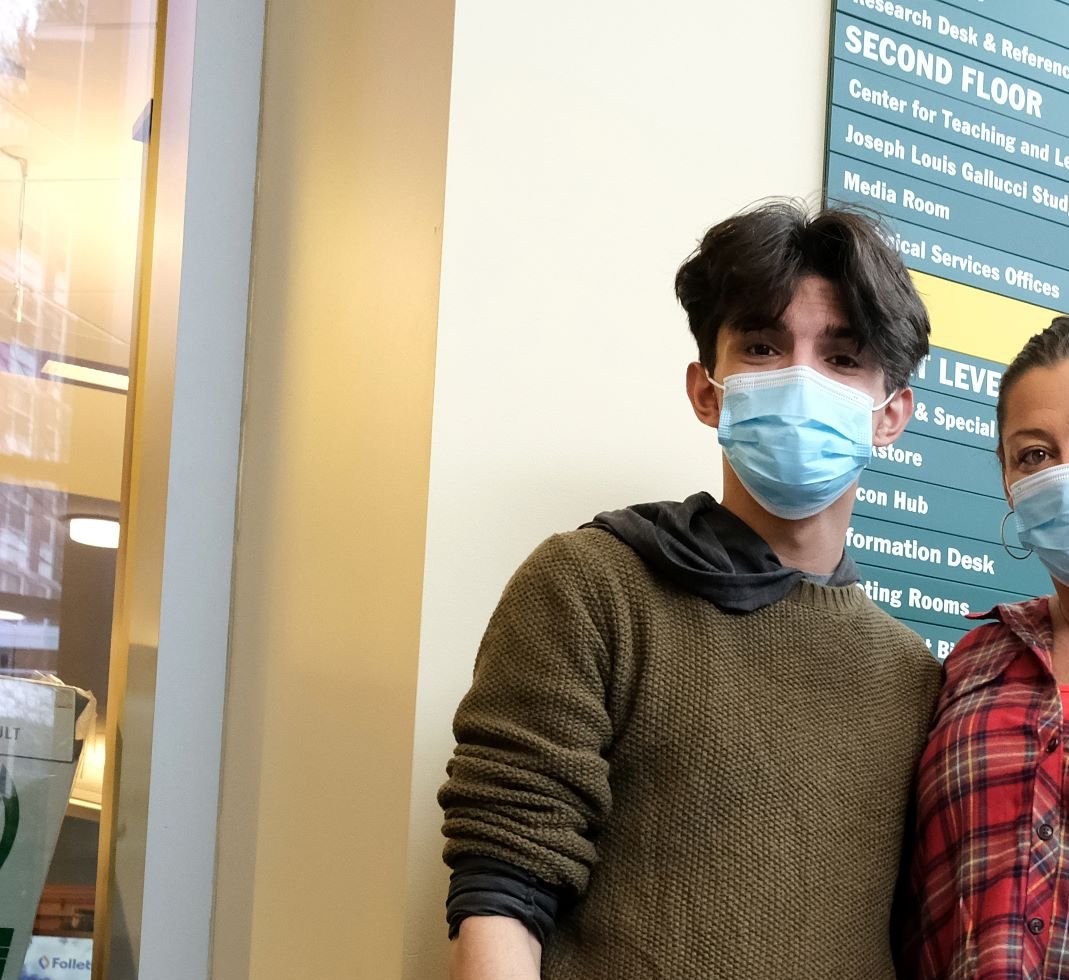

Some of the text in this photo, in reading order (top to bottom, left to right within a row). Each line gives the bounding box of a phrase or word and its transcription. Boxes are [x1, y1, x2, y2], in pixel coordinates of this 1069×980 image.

[853, 0, 932, 30] esearch
[938, 15, 978, 47] Desk
[983, 33, 996, 53] &
[844, 25, 1043, 118] SECOND FLOOR
[849, 79, 907, 113] Center
[912, 100, 937, 124] for
[942, 109, 1016, 153] Teaching
[1020, 140, 1049, 163] and
[845, 124, 905, 160] Joseph
[911, 144, 957, 176] Louis
[961, 162, 1028, 199] Gallucci
[844, 171, 950, 220] Media Room
[931, 244, 1000, 281] Services
[1005, 266, 1060, 299] Offices
[939, 357, 1000, 398] LEVE
[915, 402, 995, 438] & Special
[872, 443, 923, 467] store
[893, 490, 929, 514] Hub
[846, 527, 995, 575] formation Desk
[908, 587, 970, 616] Rooms
[52, 957, 90, 970] Follet
